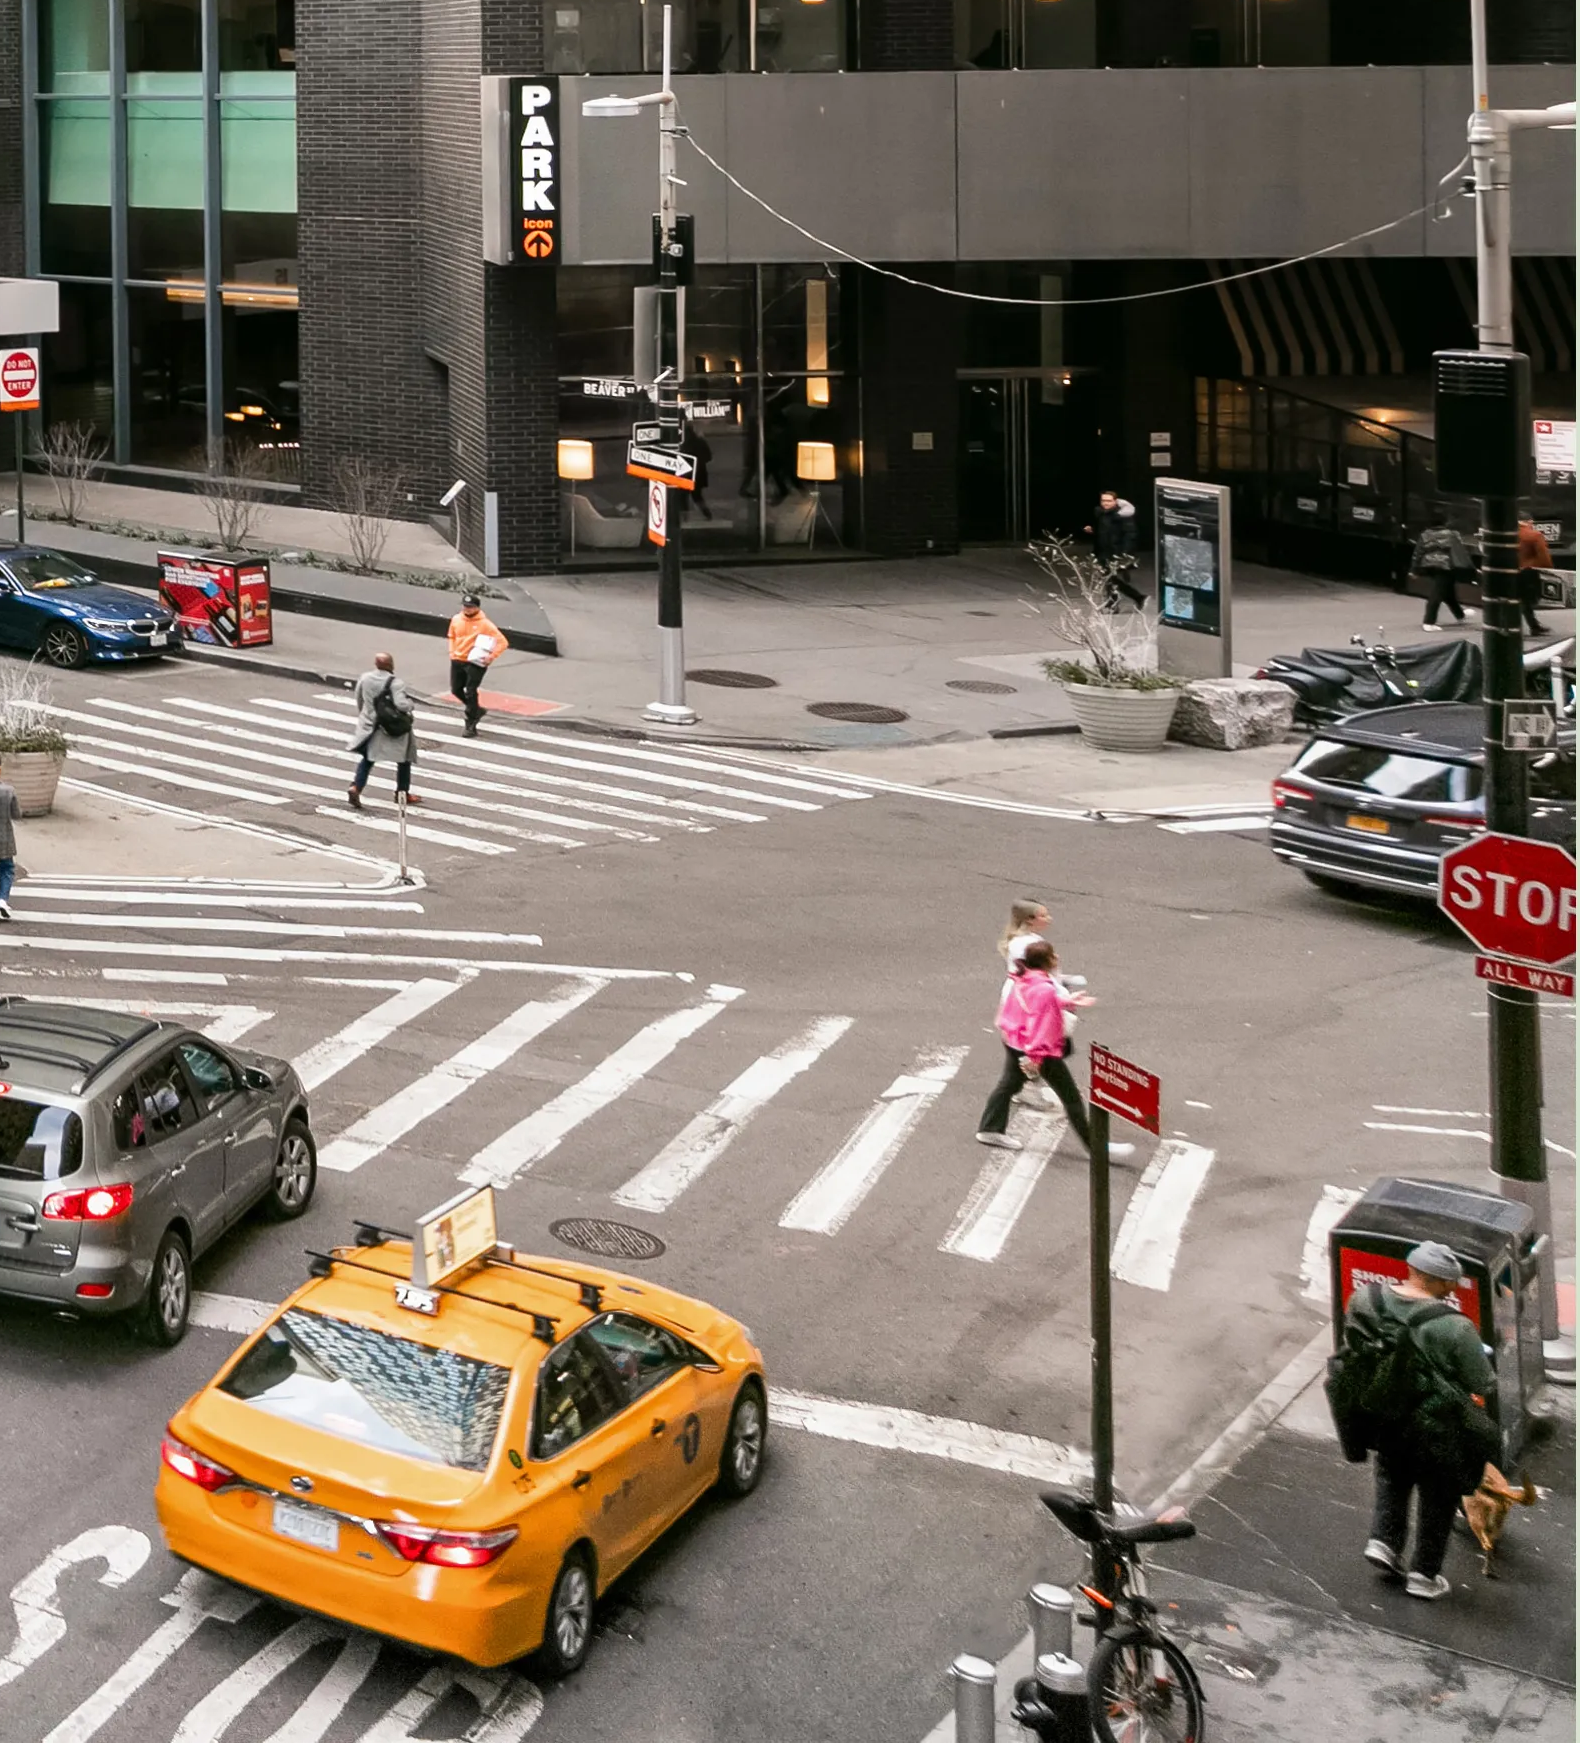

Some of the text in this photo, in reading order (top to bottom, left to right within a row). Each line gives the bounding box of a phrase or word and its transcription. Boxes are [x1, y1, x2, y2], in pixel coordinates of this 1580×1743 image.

[520, 85, 555, 211] PARK
[523, 217, 554, 229] icon
[6, 359, 32, 369] DO NOT
[7, 381, 31, 391] ENTER
[583, 382, 626, 397] BEAVER
[633, 451, 684, 470] ONE WAY
[1483, 962, 1567, 991] ALL WAY
[1093, 1051, 1150, 1088] NO STANDING
[1094, 1065, 1129, 1092] Anytime
